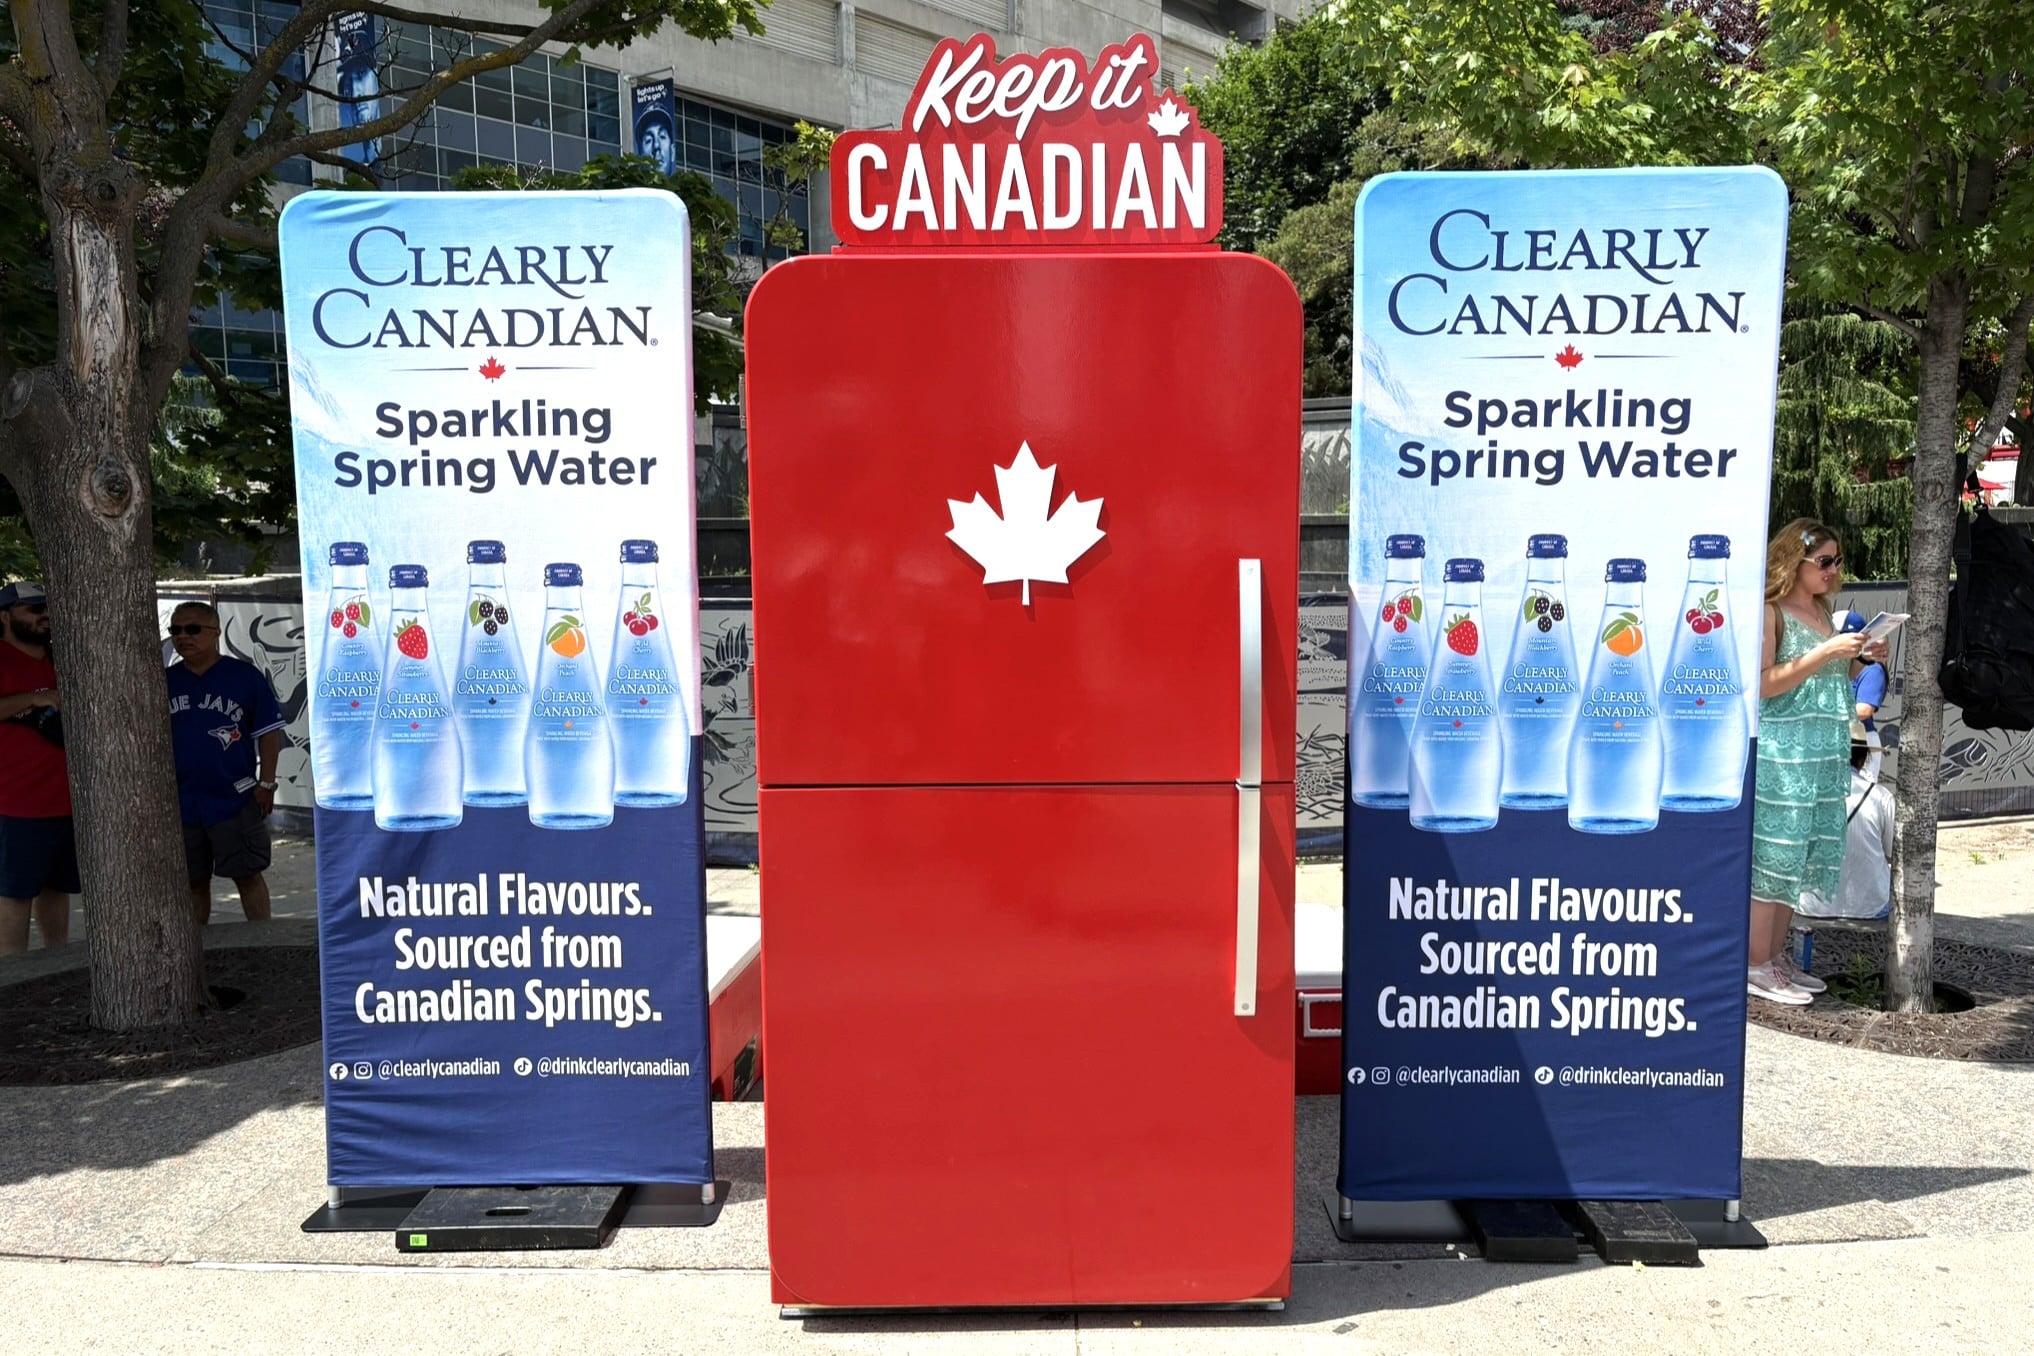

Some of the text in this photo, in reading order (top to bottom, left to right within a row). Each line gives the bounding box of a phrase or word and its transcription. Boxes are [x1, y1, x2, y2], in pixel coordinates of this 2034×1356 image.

[652, 92, 661, 101] go
[655, 84, 665, 92] up
[912, 43, 1148, 141] Keep it
[847, 142, 1206, 231] CANADIAN
[349, 226, 614, 300] CLEARLY
[1429, 208, 1710, 286] CLEARLY
[375, 398, 612, 445] Sparkling
[1443, 388, 1692, 436] Sparkling
[334, 449, 657, 495] Spring Water
[1397, 439, 1737, 486] Spring Water
[169, 693, 244, 722] UE JAYS
[318, 683, 379, 698] CANADIA
[1363, 677, 1424, 693] CANADIA
[359, 872, 653, 918] Natural Flavours.
[1388, 877, 1694, 923] Natural Flavours.
[394, 925, 623, 970] Sourced from
[1419, 932, 1658, 977] Sourced from
[354, 978, 663, 1028] Canadian Springs.
[1377, 986, 1697, 1038] Canadian Springs.
[377, 1056, 690, 1080] @clearlycanadian @drinkclearlycanadian
[1395, 1065, 1724, 1088] @clearlycanadian @drinkclearlycanadian
